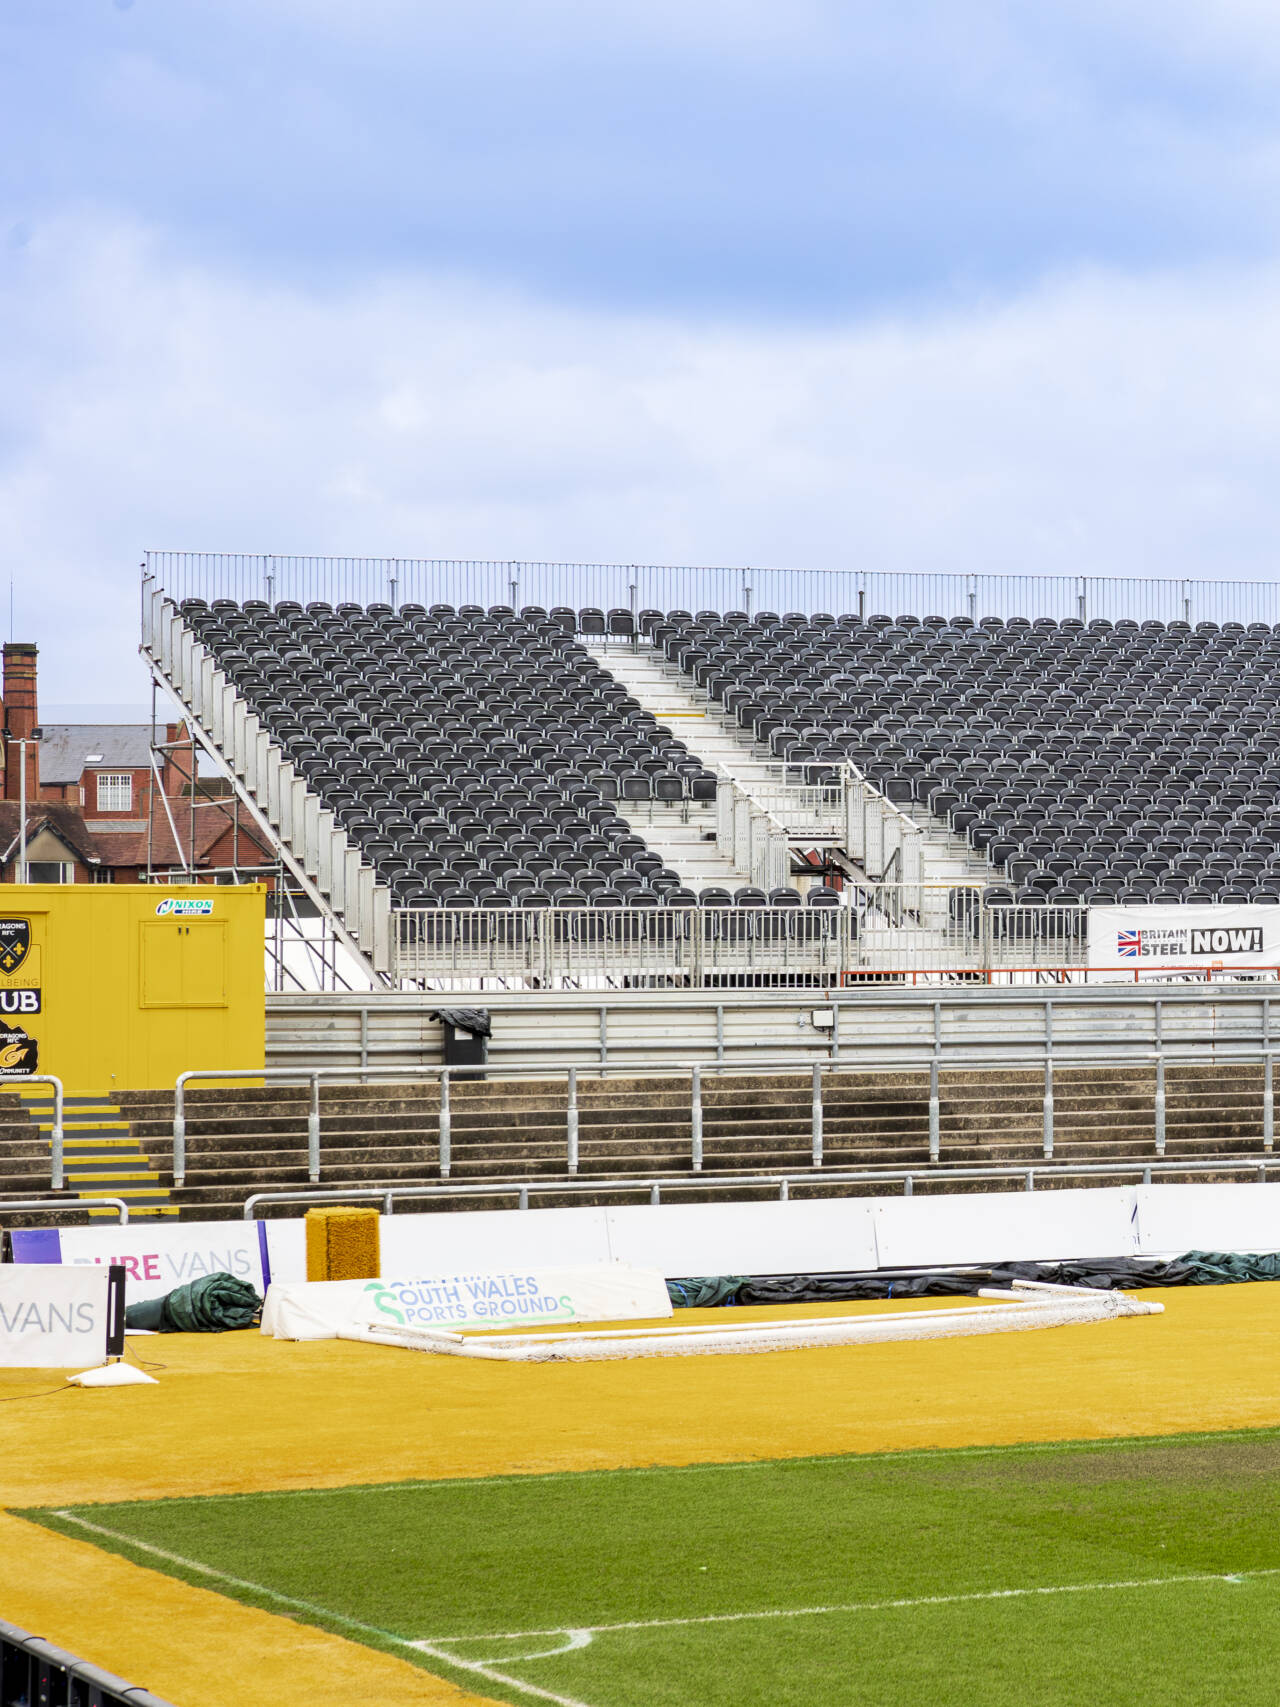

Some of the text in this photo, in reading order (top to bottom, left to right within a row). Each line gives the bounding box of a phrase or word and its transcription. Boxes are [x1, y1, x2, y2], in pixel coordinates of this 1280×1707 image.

[174, 900, 213, 909] NIXON
[1141, 929, 1188, 940] BRITAIN
[1141, 929, 1261, 956] STEEL NOW!
[0, 978, 38, 987] LBEING
[0, 991, 39, 1012] UB
[165, 1249, 250, 1279] VANS
[466, 1276, 539, 1299] WALES
[473, 1295, 575, 1316] GROUNDS
[0, 1302, 95, 1333] VANS
